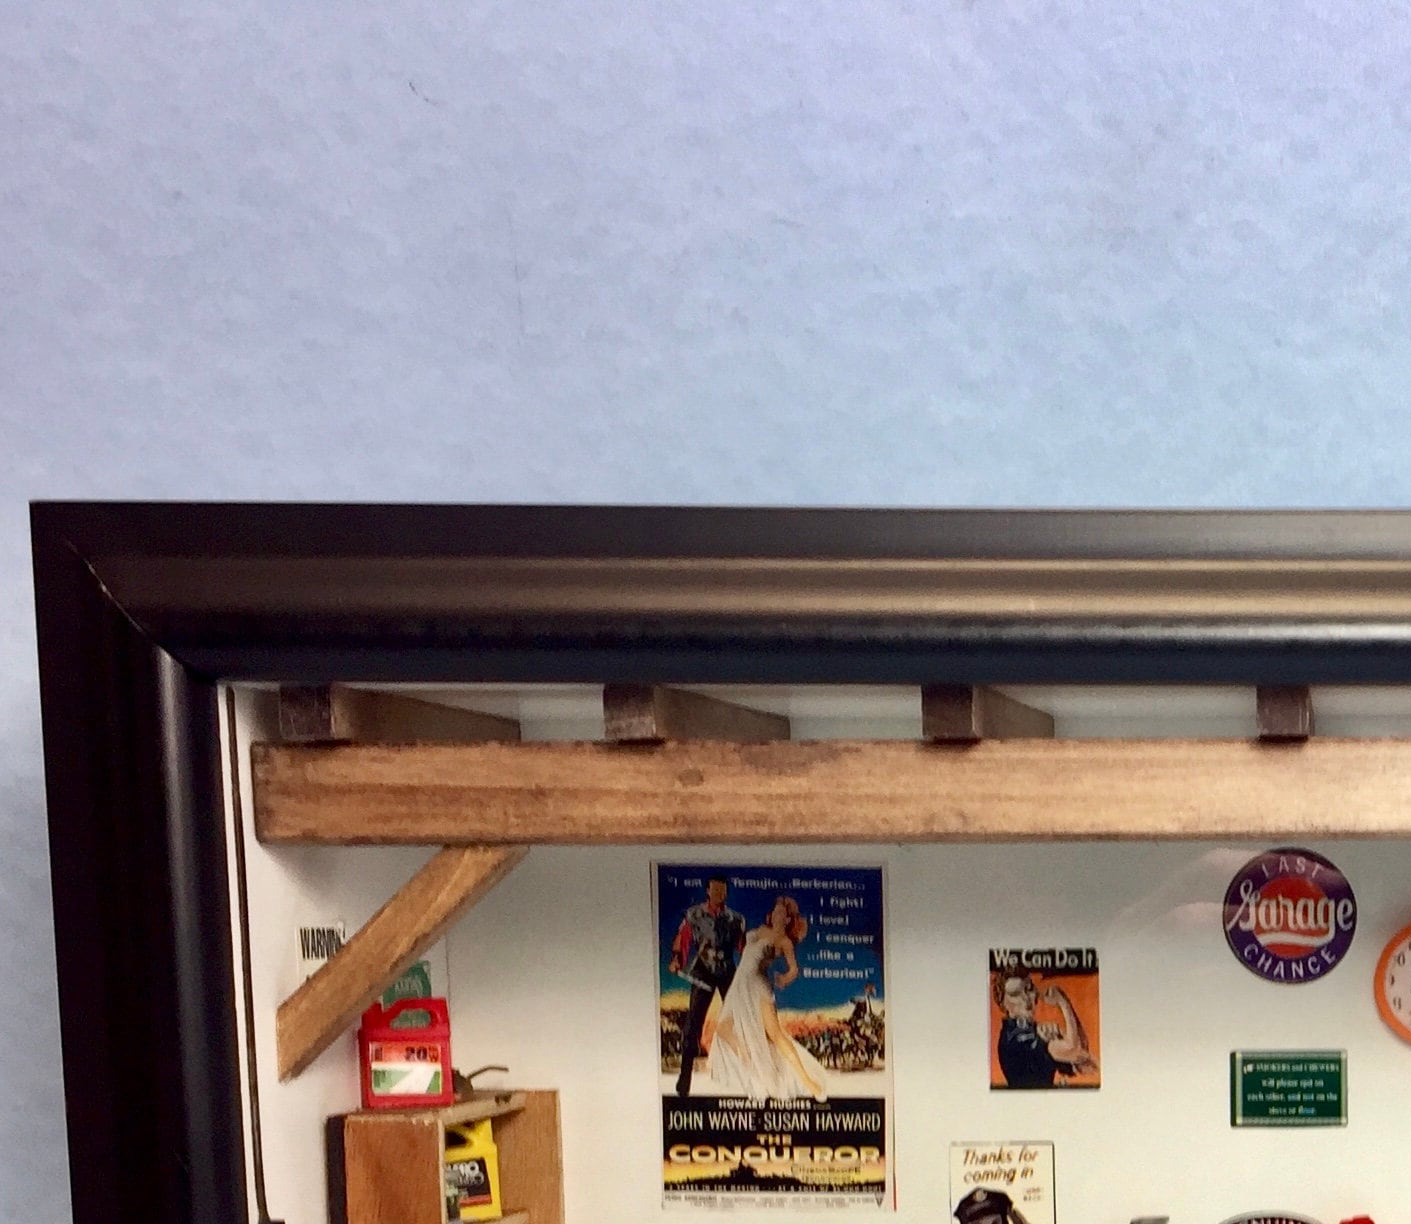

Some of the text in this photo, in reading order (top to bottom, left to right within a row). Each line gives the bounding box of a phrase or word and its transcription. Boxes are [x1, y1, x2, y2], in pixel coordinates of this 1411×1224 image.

[1227, 879, 1353, 948] Garage
[994, 949, 1018, 968] We
[1021, 949, 1052, 968] Can
[1055, 949, 1079, 968] Do
[1244, 943, 1336, 979] CHANCE
[718, 1098, 765, 1110] HOWARD
[769, 1098, 812, 1110] HUGHES
[668, 1110, 881, 1132] JOHN WAYNE SUSAN HAYWARD
[756, 1133, 792, 1146] THE
[668, 1144, 880, 1164] CONQUEROR
[964, 1144, 1038, 1166] Thanks for
[964, 1166, 1034, 1185] coming in
